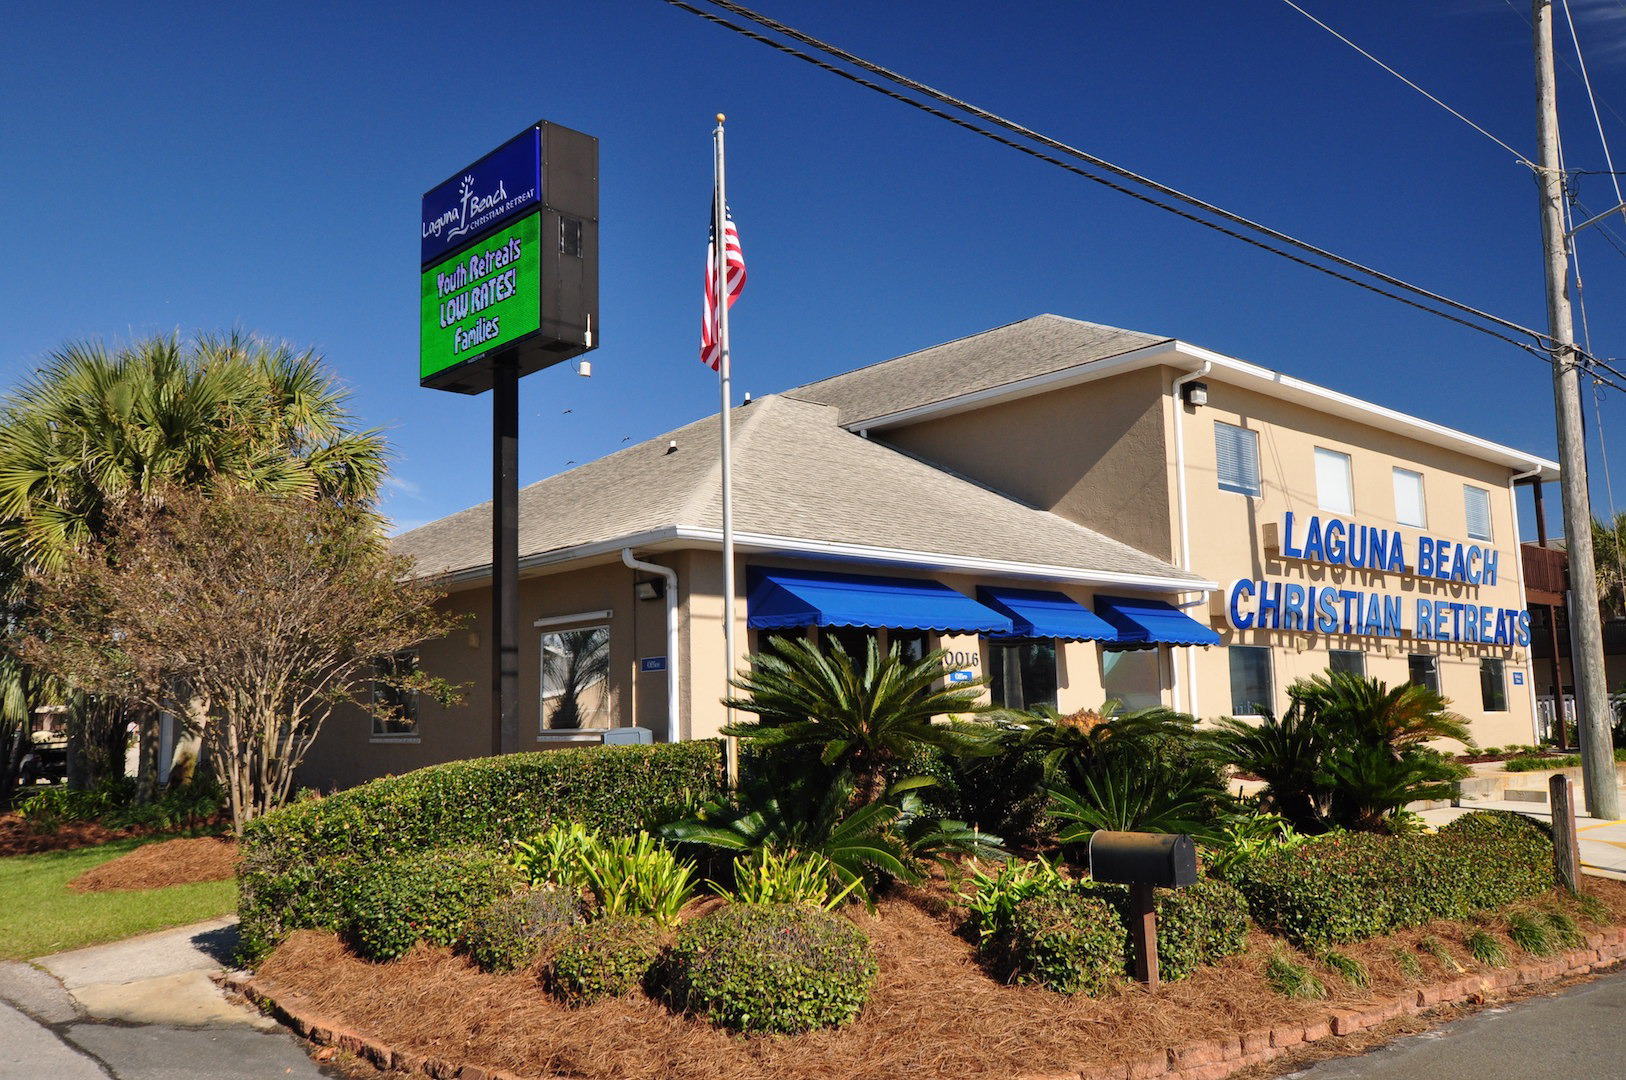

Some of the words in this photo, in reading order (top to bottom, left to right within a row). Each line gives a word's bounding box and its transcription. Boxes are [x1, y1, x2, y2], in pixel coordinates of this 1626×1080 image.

[422, 207, 460, 239] Laguna
[470, 180, 507, 218] Beach
[470, 205, 504, 230] CHRISTIAN
[505, 188, 535, 211] RETREAT
[437, 262, 467, 299] Youth
[469, 236, 521, 283] Retreats
[440, 291, 469, 329] LOW
[471, 267, 516, 315] RATES!
[454, 316, 499, 355] Families
[1282, 511, 1406, 574] LAGUNA
[1418, 536, 1498, 586] BEACH
[1228, 578, 1401, 638] CHRISTIAN
[1416, 598, 1531, 647] RETREATS
[941, 651, 979, 667] 0016
